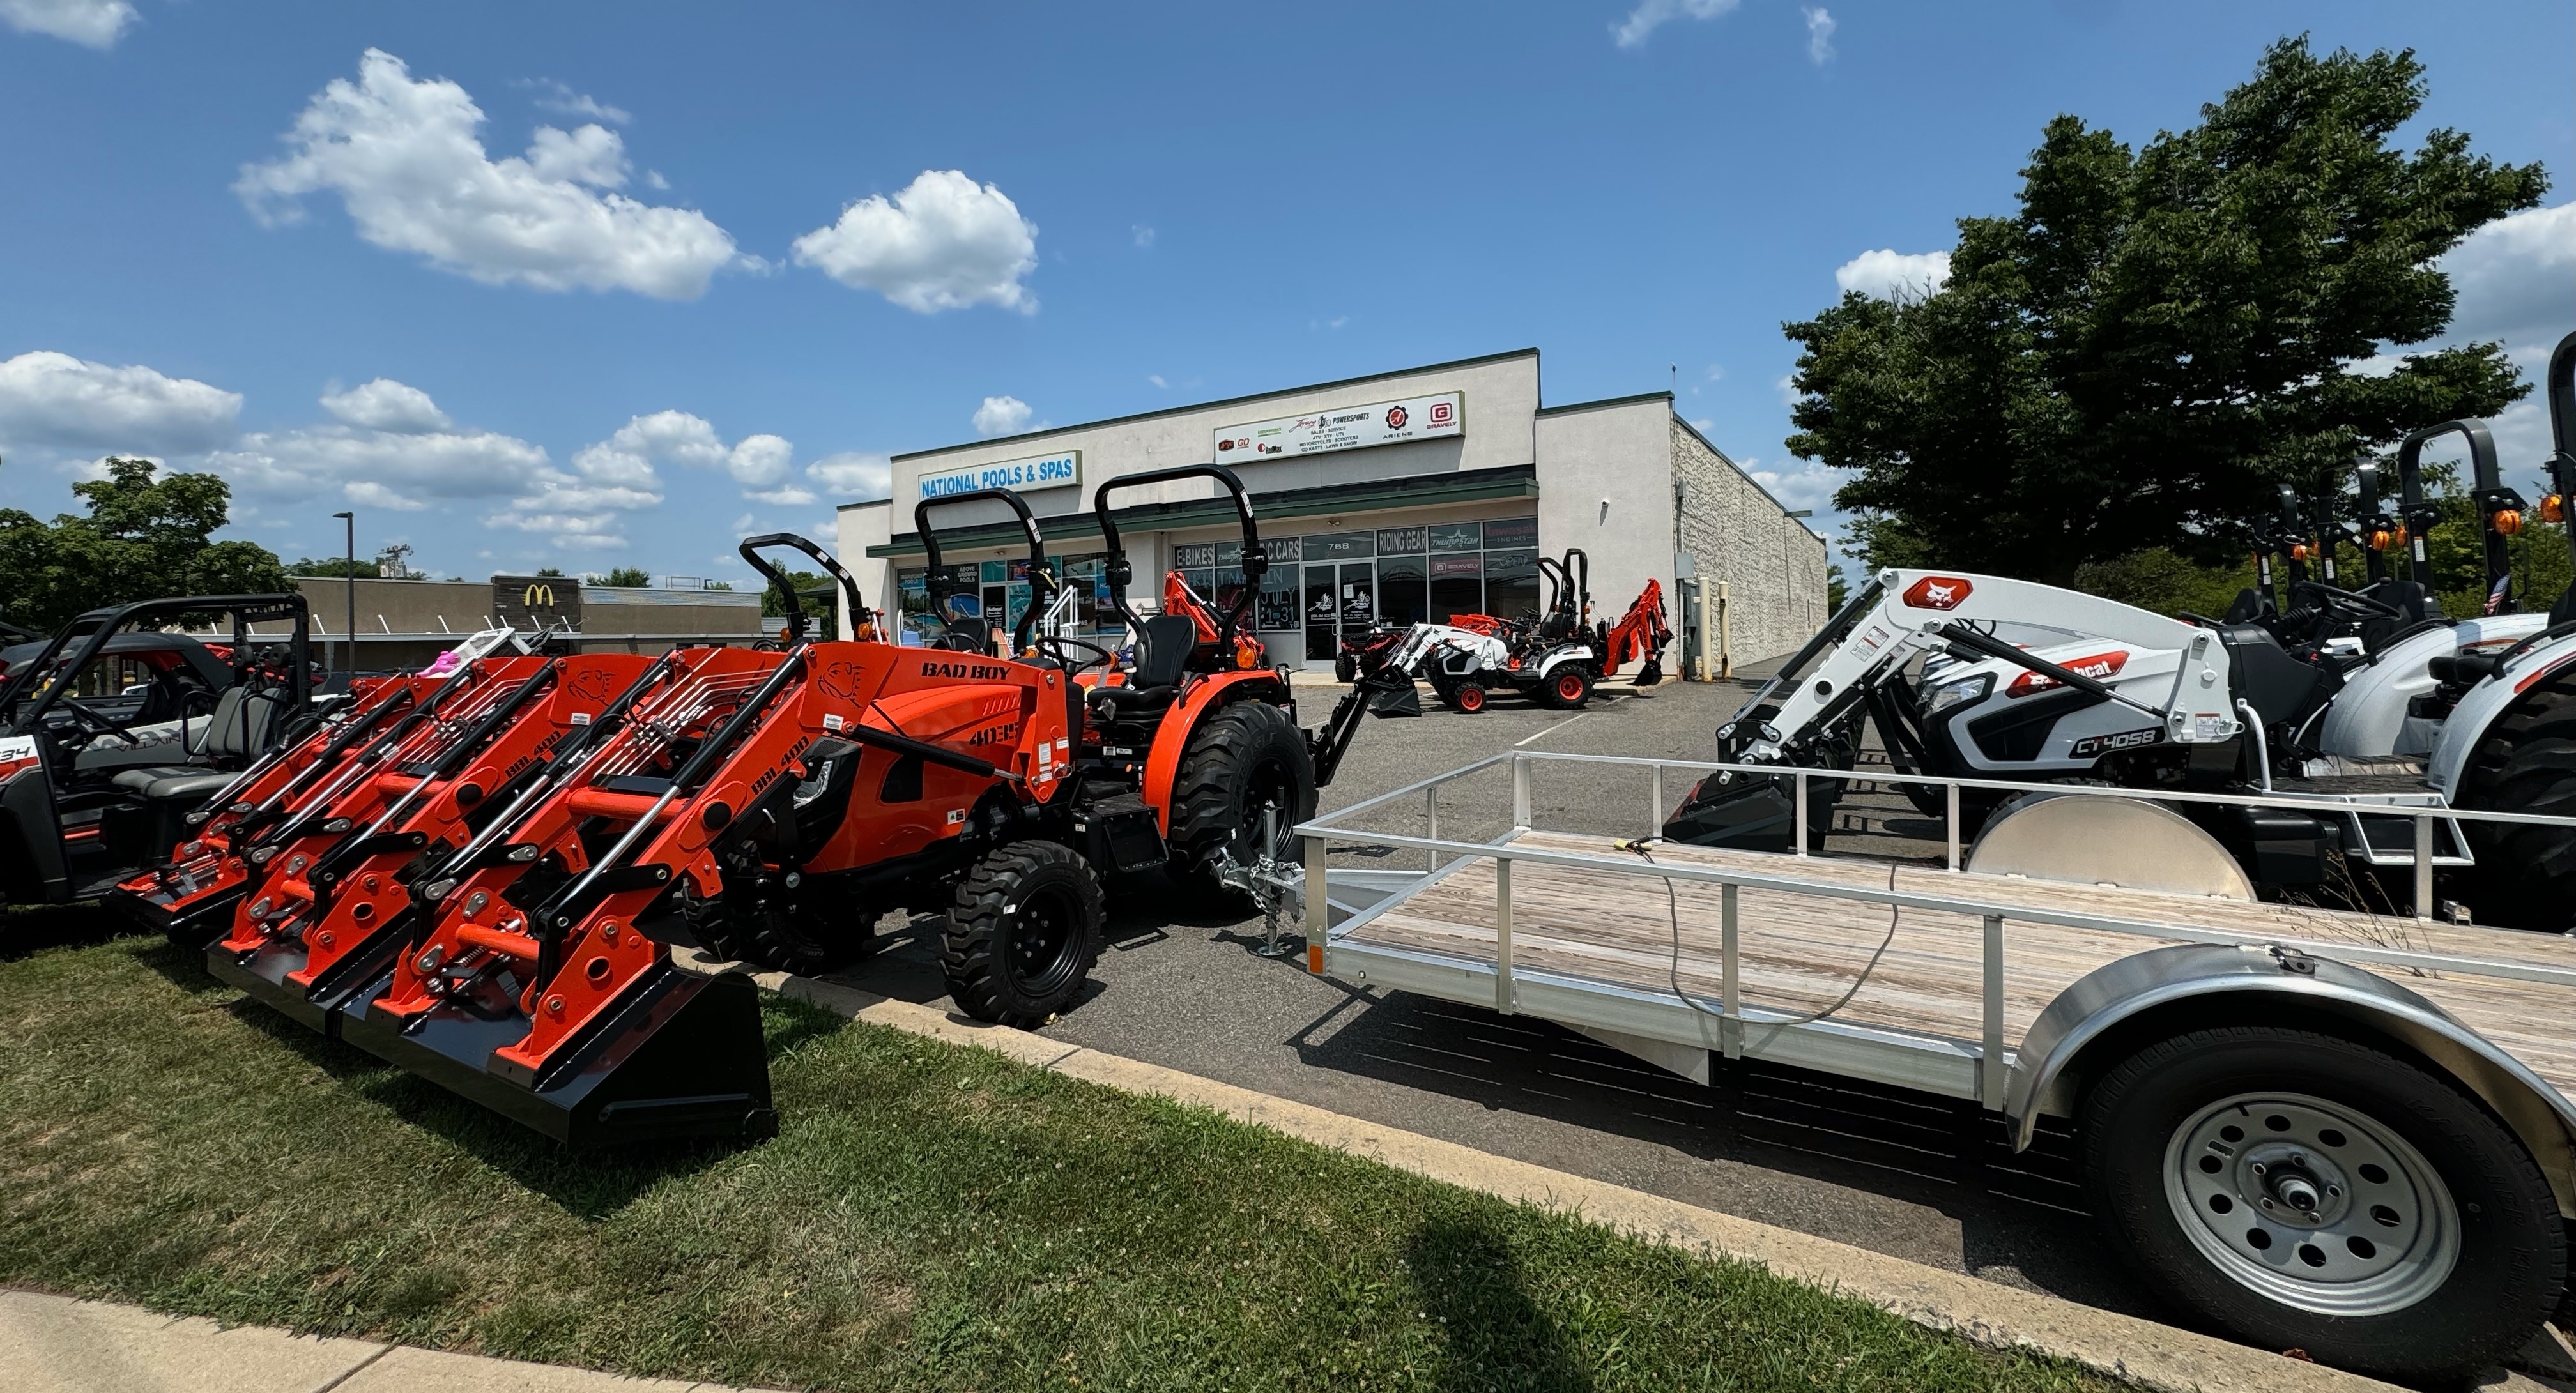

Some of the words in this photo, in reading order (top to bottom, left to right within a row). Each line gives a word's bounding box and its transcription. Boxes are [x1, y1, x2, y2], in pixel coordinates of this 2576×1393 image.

[1332, 412, 1370, 424] POWERSPORTS
[1426, 421, 1457, 429] GRAVELY
[1238, 438, 1250, 447] GO
[1300, 439, 1331, 447] MOTORCYCLES
[1383, 431, 1413, 439] ARIENS
[922, 473, 979, 498] NATIONAL
[982, 466, 1022, 489] POOLS
[1026, 464, 1036, 482] &
[1039, 458, 1073, 481] SPAS
[1379, 531, 1404, 552] RIDING
[1406, 529, 1426, 551] GEAR
[1432, 537, 1480, 547] THUMPSTAR
[1177, 547, 1214, 567] E-BIKES
[1275, 540, 1300, 560] CARS
[1499, 556, 1528, 567] OPEN
[1013, 566, 1029, 575] OPE
[1262, 568, 1284, 585] IN
[1261, 586, 1296, 606] JULY
[921, 662, 967, 679] BAD
[970, 665, 1012, 680] BOY
[969, 722, 1020, 748] 4035
[2076, 729, 2156, 754] CT4058
[0, 745, 31, 761] 34
[505, 754, 534, 779] BBL
[533, 730, 562, 756] 400
[750, 766, 781, 796] BBL
[780, 735, 810, 768] 400
